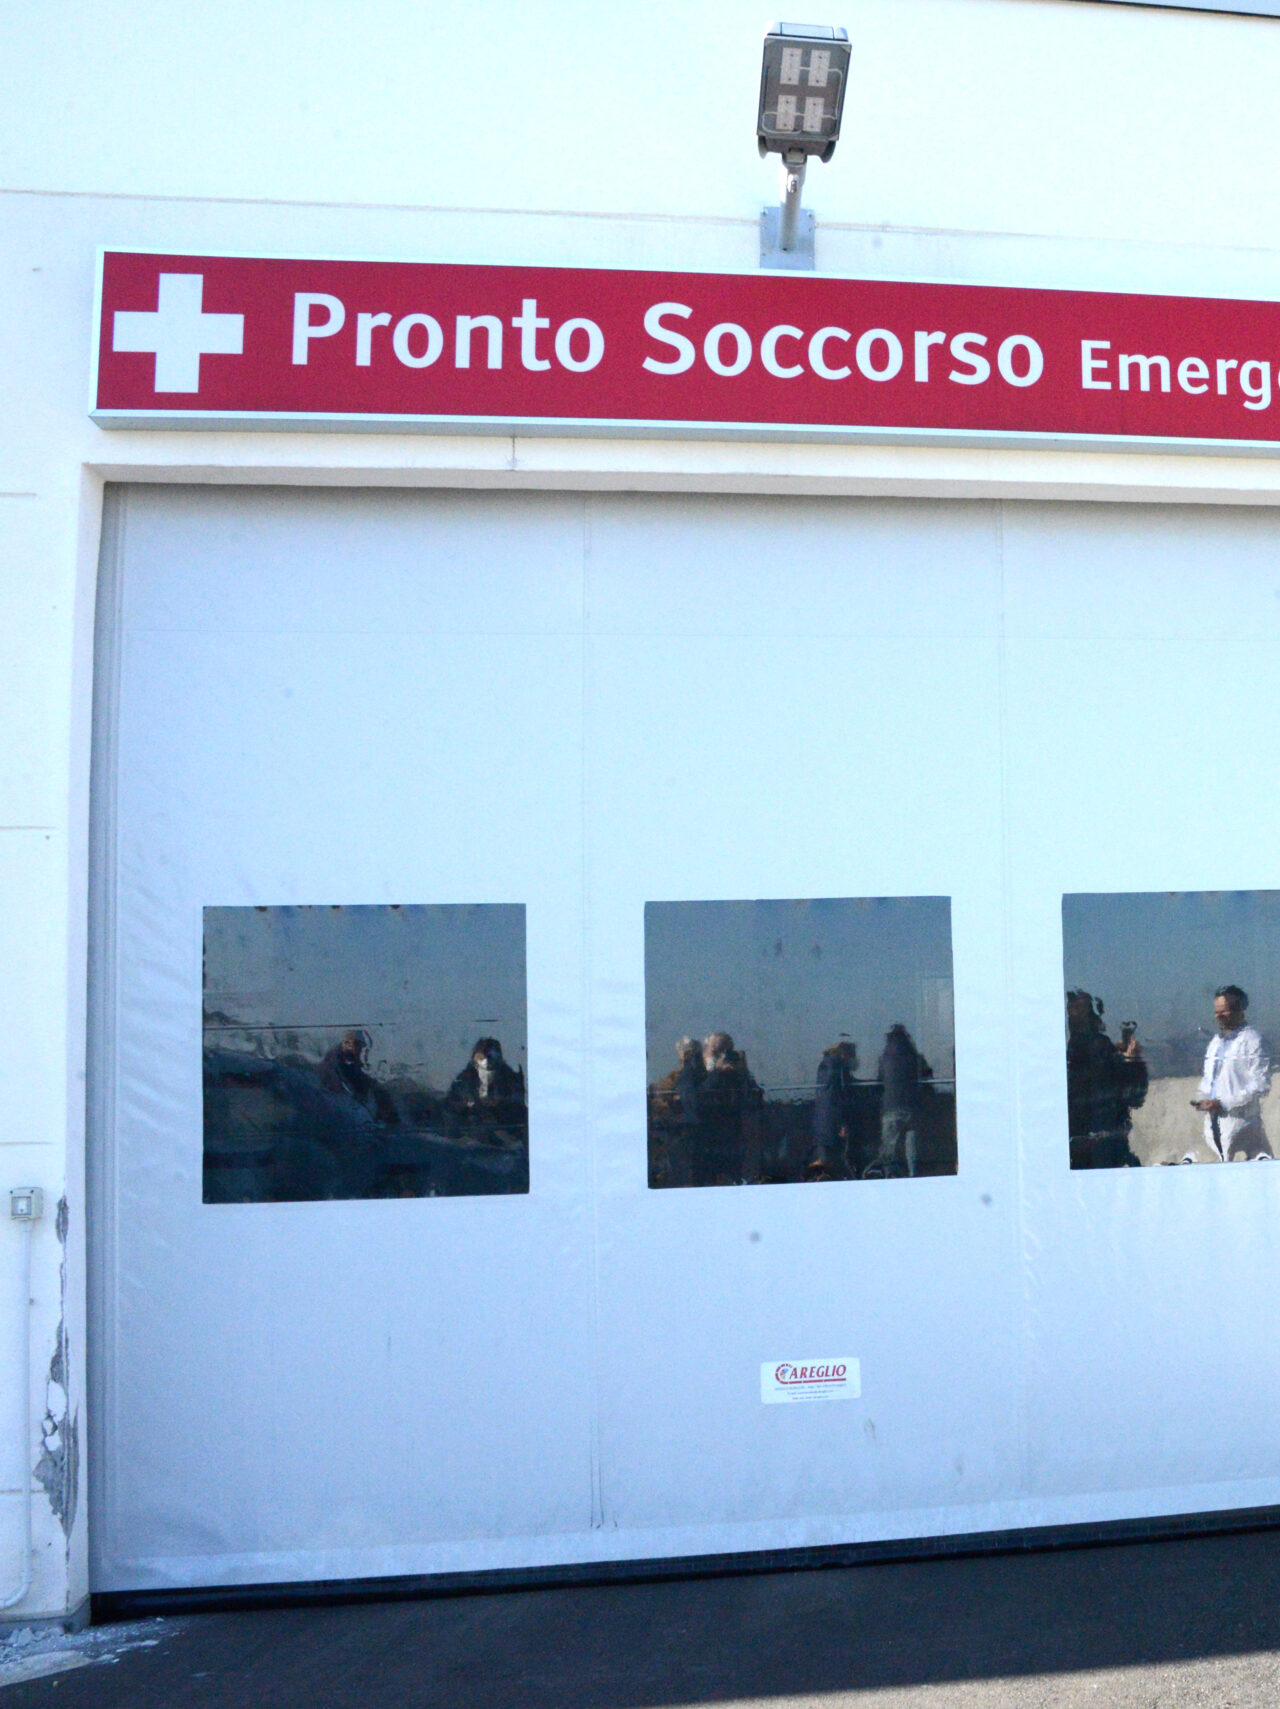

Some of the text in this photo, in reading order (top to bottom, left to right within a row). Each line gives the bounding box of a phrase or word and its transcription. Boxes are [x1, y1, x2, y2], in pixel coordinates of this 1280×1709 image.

[291, 292, 606, 374] Pronto
[641, 301, 1045, 388] Soccorso
[775, 1363, 847, 1384] CAREGLIO
